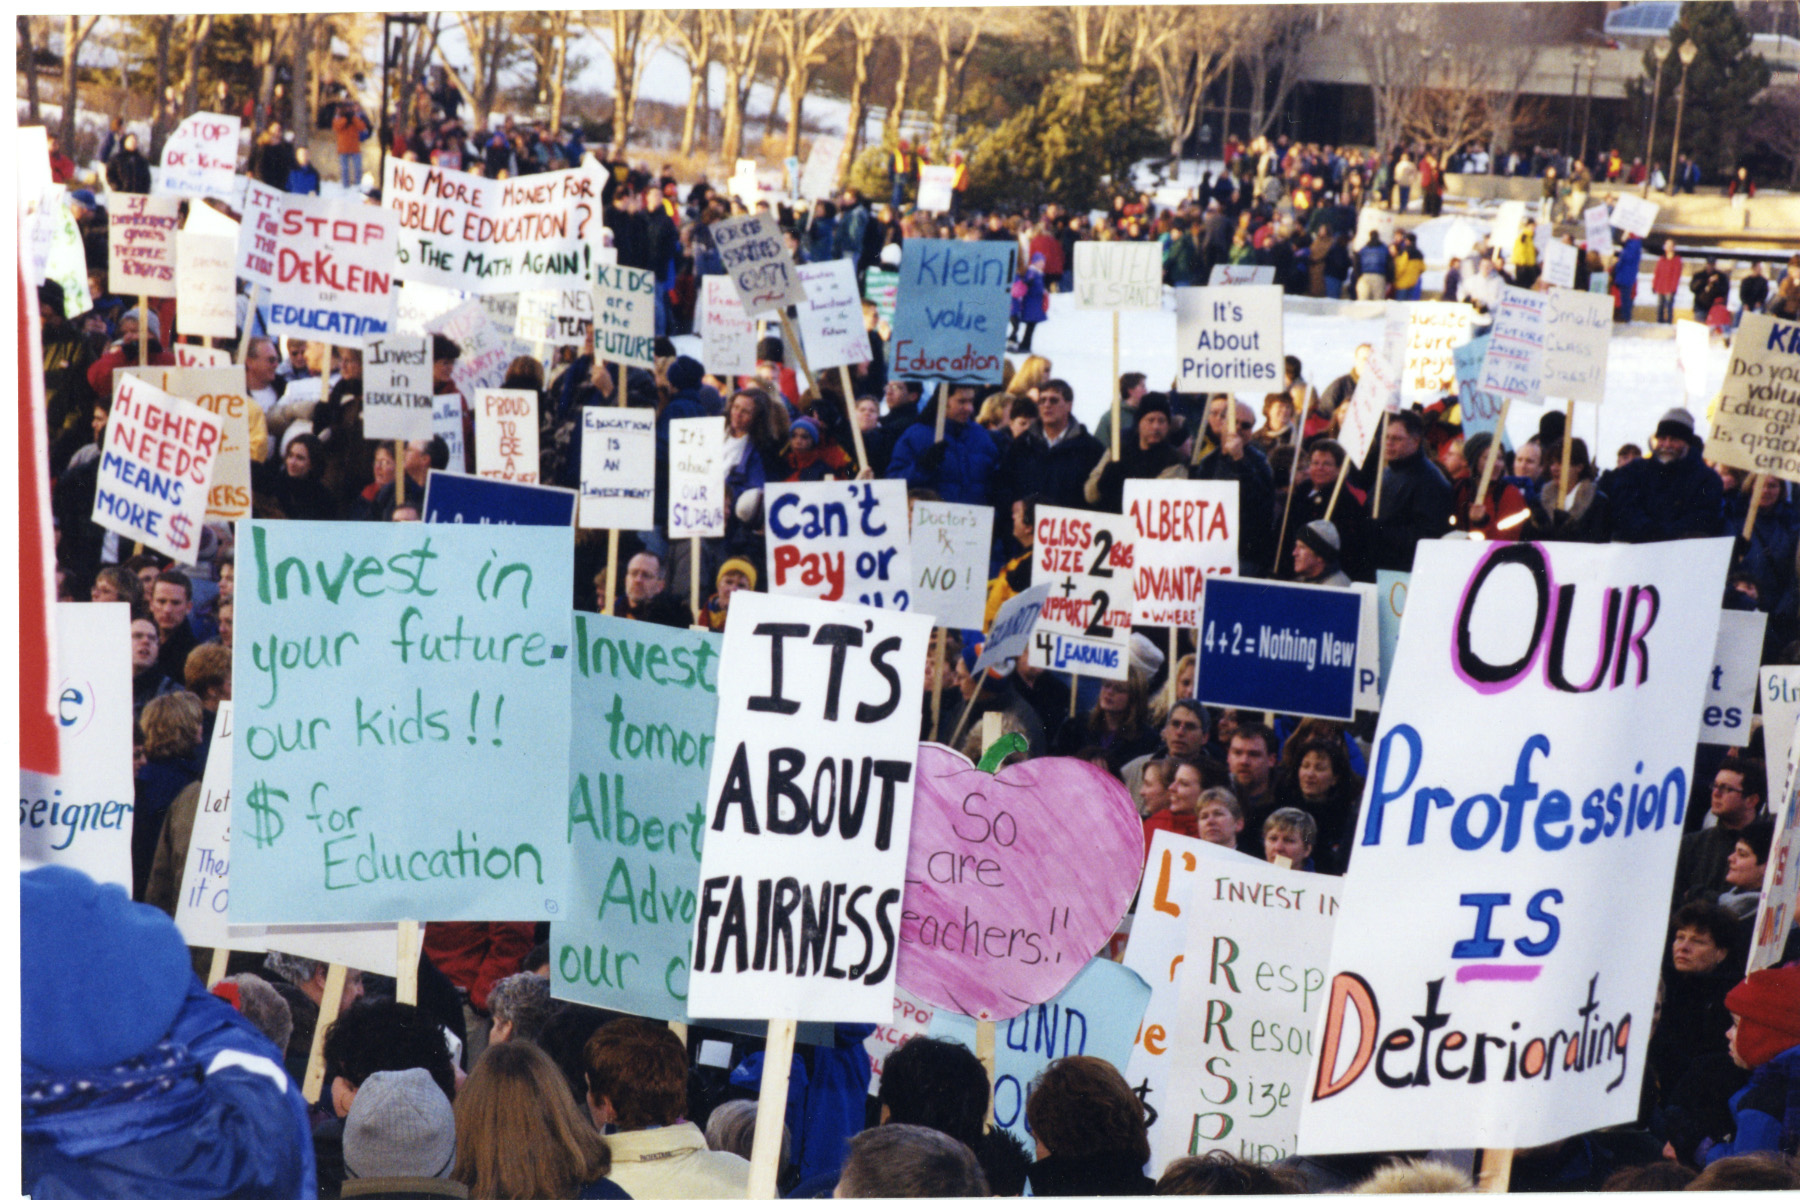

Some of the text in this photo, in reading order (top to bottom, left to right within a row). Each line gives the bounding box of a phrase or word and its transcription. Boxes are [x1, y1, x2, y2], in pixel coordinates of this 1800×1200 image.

[502, 182, 557, 206] MONEY
[563, 175, 594, 198] FOR
[282, 209, 384, 245] STOP
[254, 234, 277, 256] THE
[418, 239, 454, 271] THE
[462, 250, 514, 278] MATH
[597, 264, 655, 295] KIDS
[918, 244, 1016, 294] Klein!
[271, 303, 387, 336] EDUCATION
[603, 311, 630, 328] the
[606, 295, 634, 312] are
[926, 301, 987, 332] value
[1213, 301, 1243, 322] It's
[368, 339, 426, 366] Invest
[594, 329, 656, 362] FUTURE
[895, 340, 1000, 373] Education
[1197, 330, 1260, 351] About
[390, 369, 409, 388] in
[1182, 358, 1277, 380] Priorities
[1733, 357, 1763, 377] Do
[366, 391, 434, 409] EDUCATION
[485, 396, 531, 418] PROUD
[114, 384, 219, 457] HIGHER
[497, 421, 517, 438] TO
[585, 411, 653, 431] EDUCATION
[1765, 421, 1792, 437] or
[114, 422, 208, 484] NEEDS
[500, 438, 523, 457] BE
[607, 438, 621, 451] IS
[103, 450, 185, 506] MEANS
[505, 457, 517, 472] A
[604, 459, 621, 472] AN
[677, 458, 714, 474] about
[581, 481, 654, 498] INVESTMENT
[682, 484, 708, 501] OUR
[97, 489, 193, 549] MORE $
[769, 482, 888, 540] Can't
[918, 507, 979, 528] Doctor's
[1130, 499, 1229, 542] ALBERTA
[1037, 518, 1092, 550] CLASS
[252, 525, 533, 609] Invest in
[1041, 547, 1085, 573] SIZE
[1088, 529, 1134, 578] 2 BIG
[774, 544, 845, 602] Pay
[856, 546, 898, 582] or
[1083, 589, 1114, 638] 2
[1151, 609, 1196, 626] WHERE
[1451, 540, 1660, 695] OUR
[575, 615, 720, 693] Invest
[1036, 633, 1119, 669] 4 LEARNING
[1204, 620, 1355, 671] 4 + 2 = Nothing New
[252, 632, 359, 709] your
[747, 618, 902, 724] IT'S
[247, 718, 330, 761] our
[711, 741, 913, 851] ABOUT
[1361, 723, 1687, 853] Profession
[242, 779, 361, 849] $ for
[952, 792, 1017, 847] So
[323, 831, 543, 891] Education
[927, 851, 1005, 888] are
[189, 877, 208, 908] it
[1213, 877, 1306, 911] INVEST
[693, 875, 901, 986] FAIRNESS
[897, 905, 1070, 965] eachers!!
[1451, 888, 1564, 959] IS
[559, 944, 640, 990] our
[1311, 971, 1632, 1103] Deteriorating
[1200, 1056, 1291, 1118] Size
